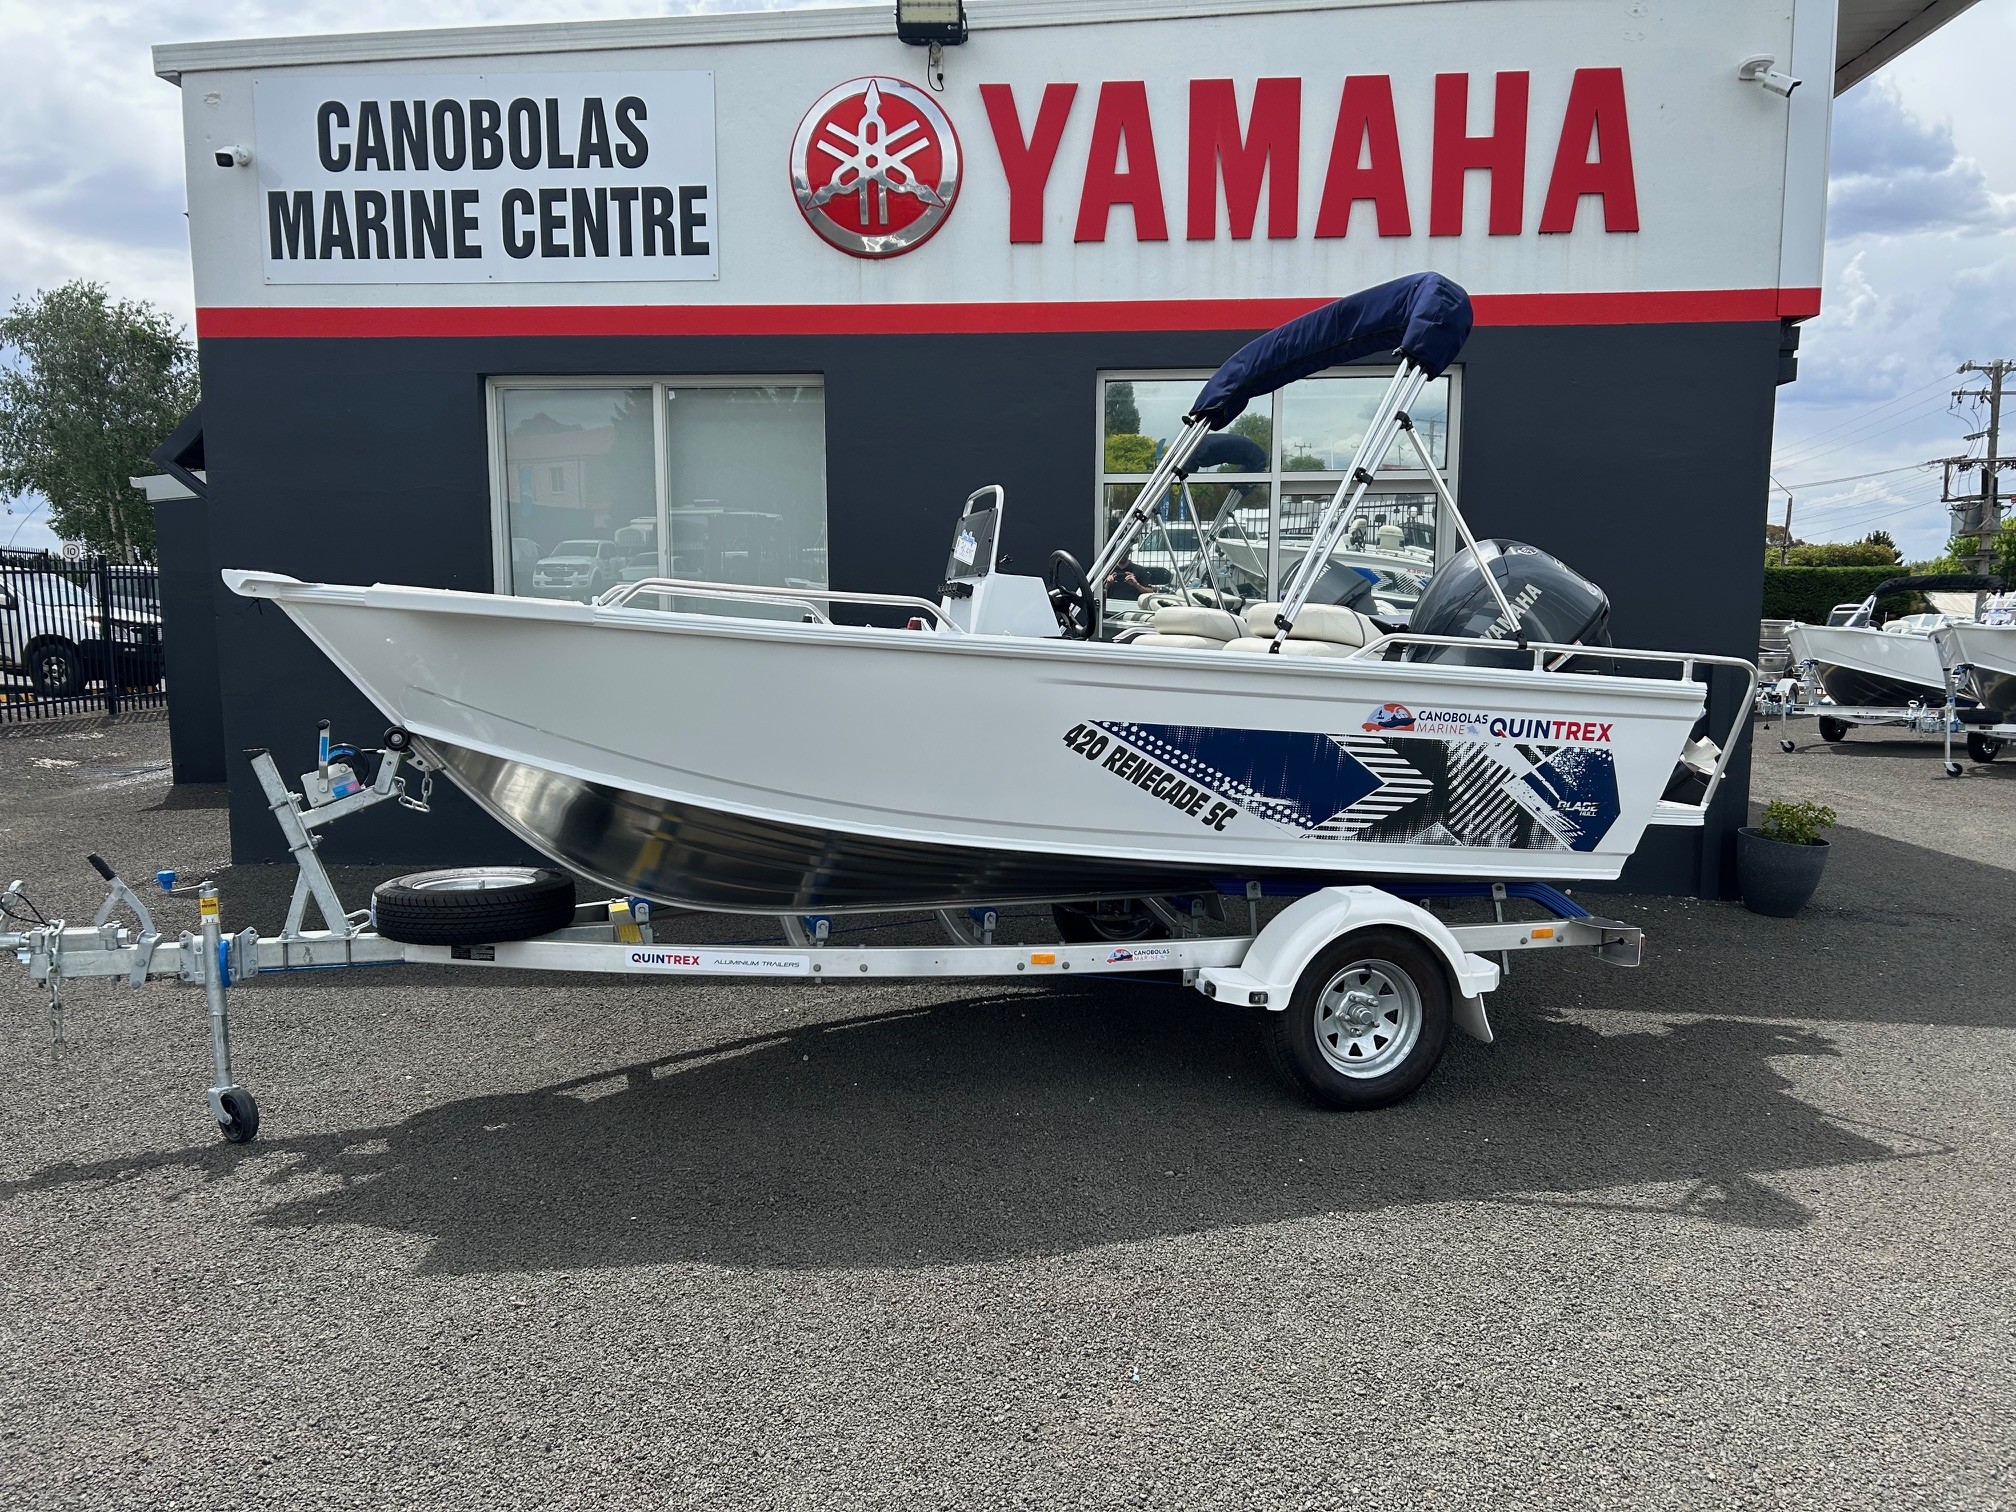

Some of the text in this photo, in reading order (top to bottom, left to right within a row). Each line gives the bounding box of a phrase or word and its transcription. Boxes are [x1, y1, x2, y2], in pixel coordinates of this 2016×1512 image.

[317, 96, 649, 172] CANOBOLAS
[978, 67, 1640, 244] YAMAHA
[267, 185, 710, 260] MARINE CENTRE
[1418, 710, 1489, 725] CANOBOLAS
[1416, 722, 1465, 735] MARINE
[1489, 717, 1613, 742] QUINTREX
[1062, 723, 1239, 832] 420 RENEGADE SC
[1556, 800, 1600, 812] BLADE
[631, 952, 800, 968] QUINTREX ALUMINIUM TRAILERS
[1133, 948, 1170, 956] CANOBOLAS
